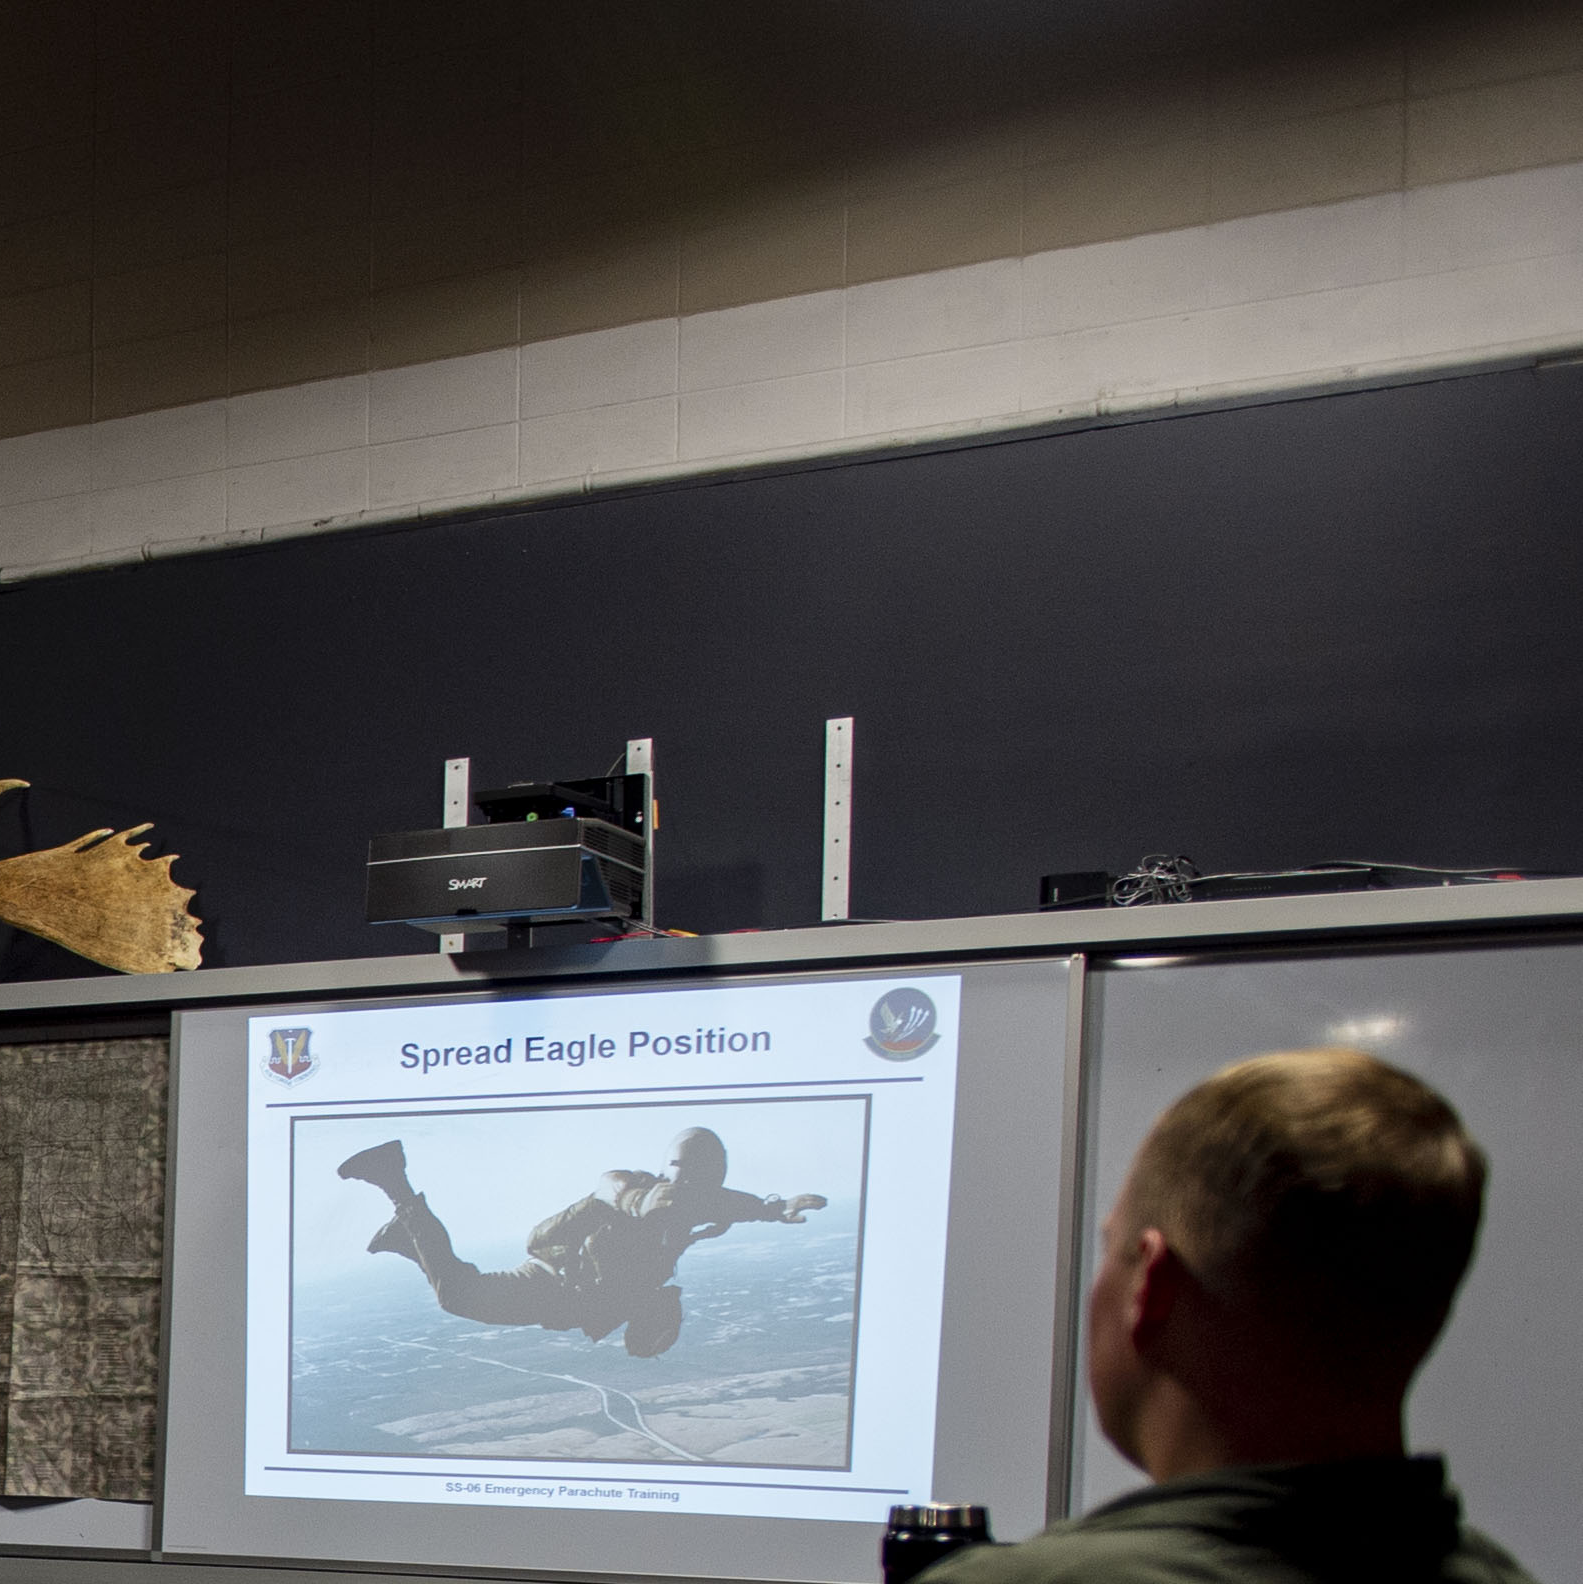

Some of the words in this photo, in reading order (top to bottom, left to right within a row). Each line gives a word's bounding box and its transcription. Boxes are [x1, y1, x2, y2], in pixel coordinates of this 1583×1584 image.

[447, 877, 488, 890] SMART
[399, 1038, 513, 1074] Spread
[524, 1034, 617, 1067] Eagle
[628, 1027, 771, 1057] Position
[445, 1482, 482, 1494] SS-06
[484, 1483, 555, 1498] Emergency
[558, 1485, 623, 1499] Parachute
[627, 1487, 680, 1503] Training
